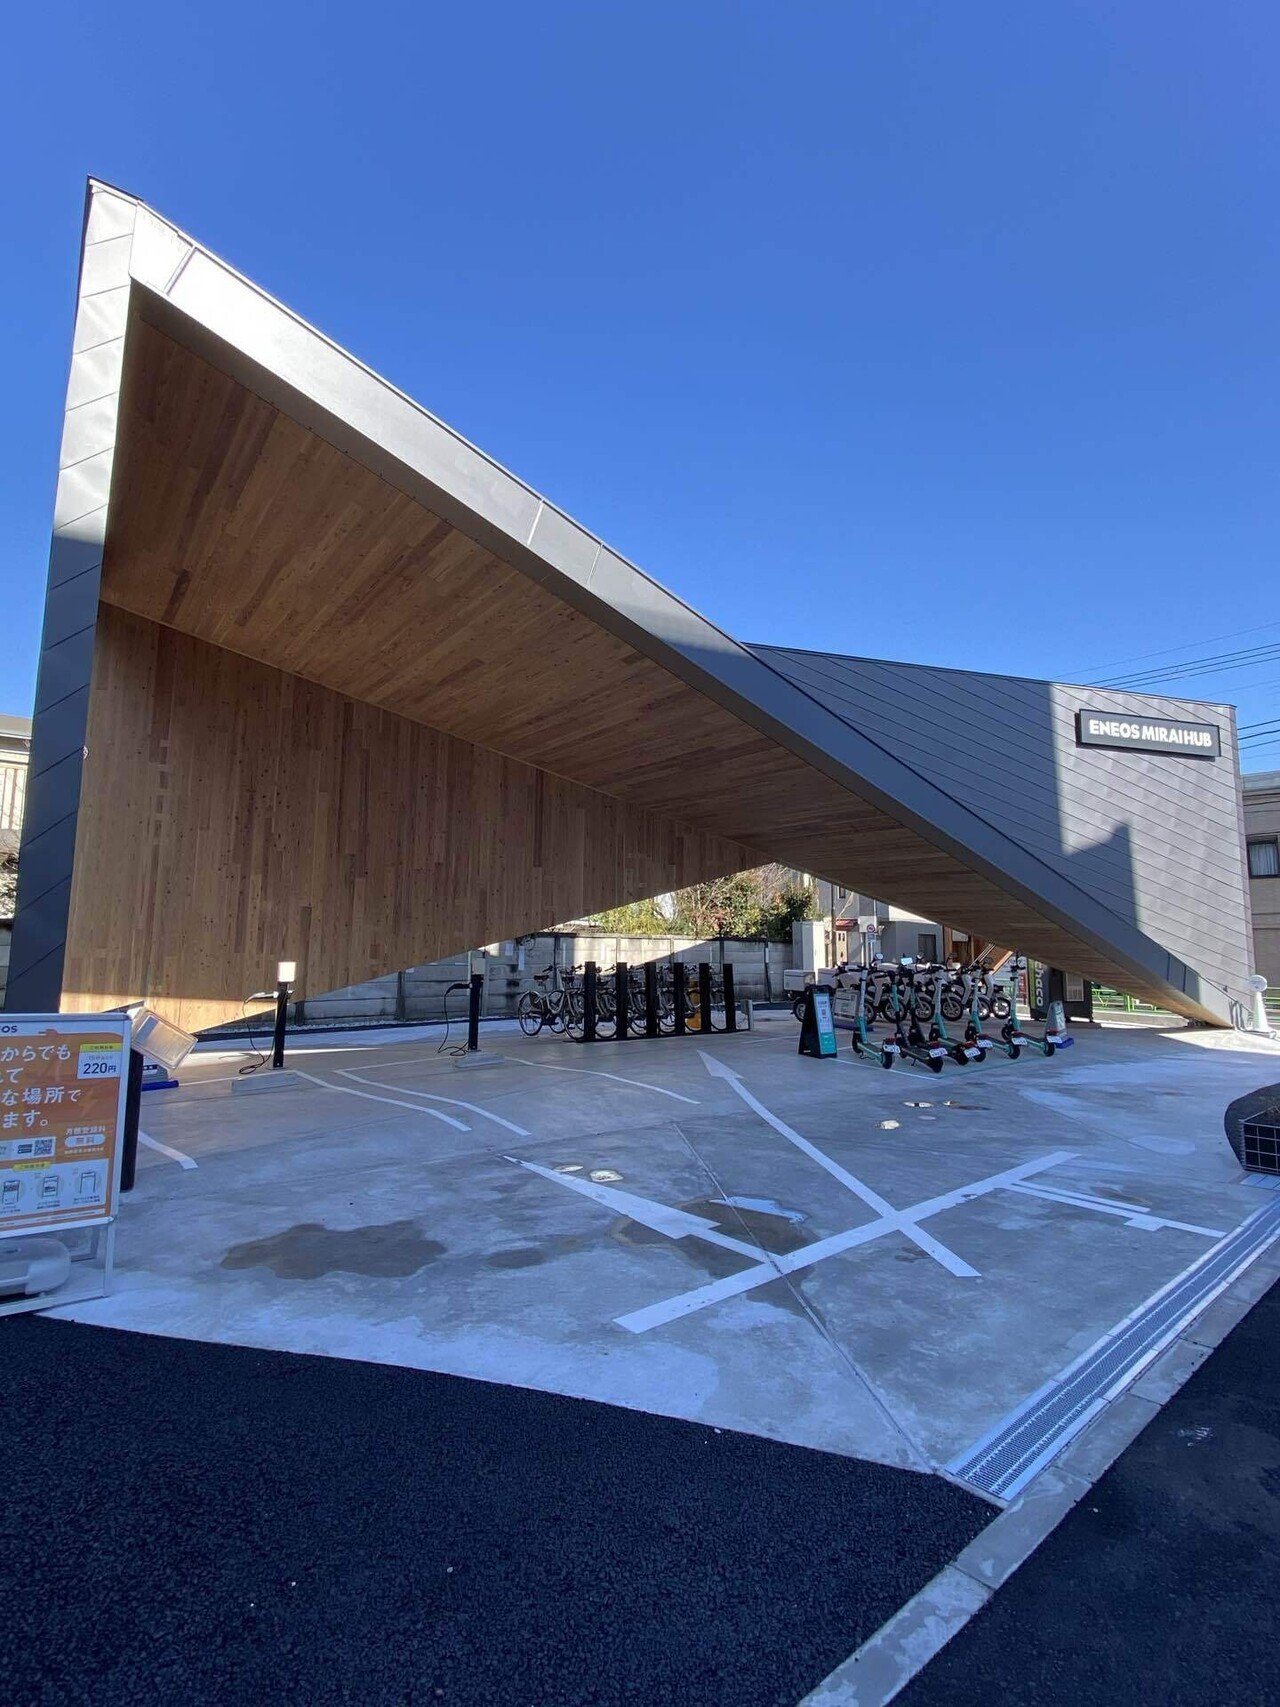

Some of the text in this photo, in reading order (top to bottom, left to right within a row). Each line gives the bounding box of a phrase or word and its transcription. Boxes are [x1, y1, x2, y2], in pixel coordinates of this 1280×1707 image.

[1089, 719, 1140, 740] ENEOS
[0, 1025, 18, 1033] OS
[83, 1062, 117, 1075] 220円
